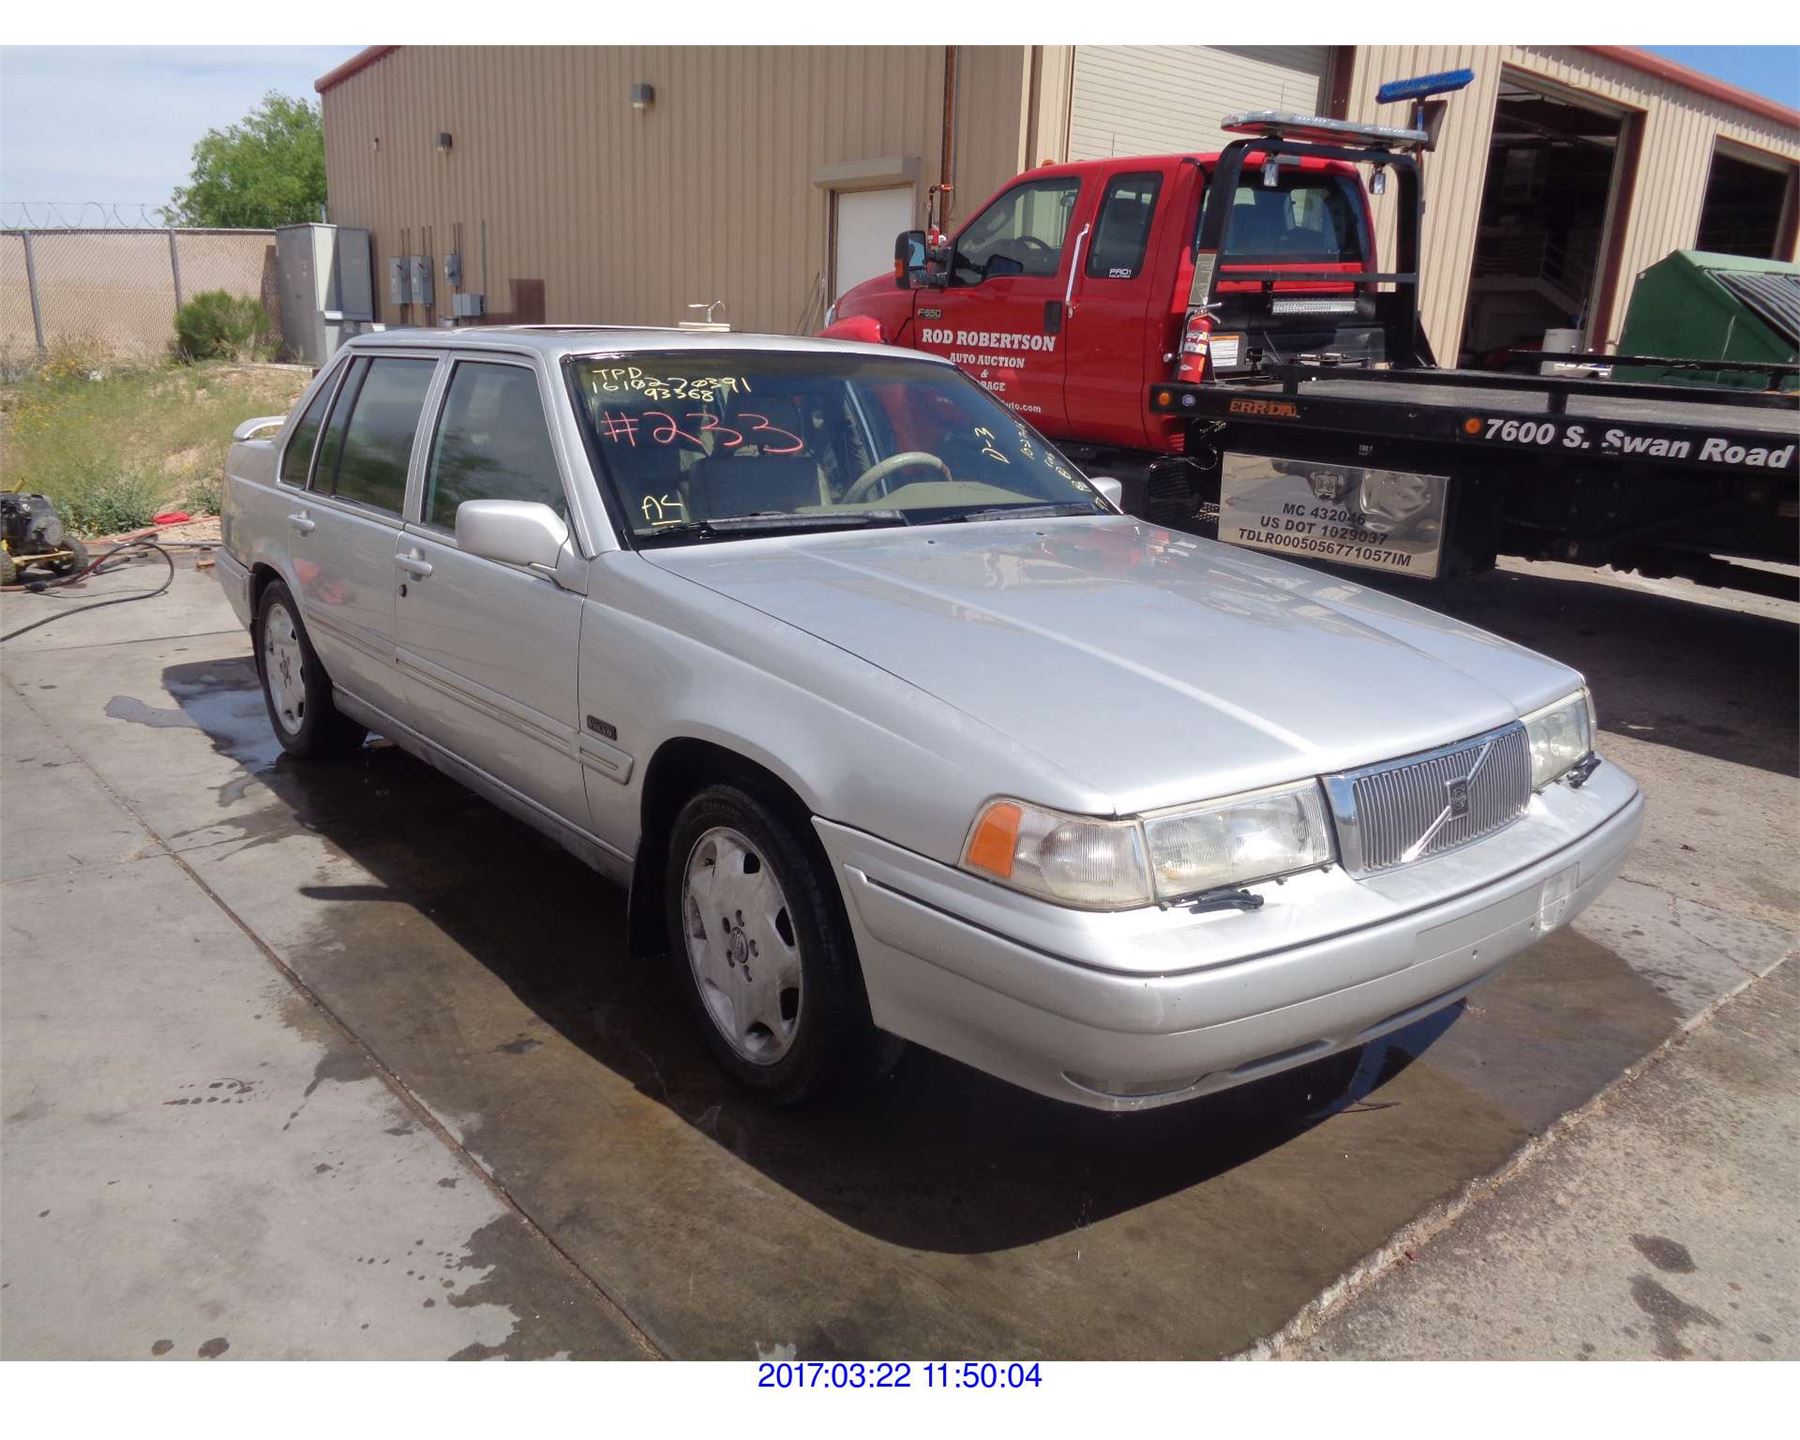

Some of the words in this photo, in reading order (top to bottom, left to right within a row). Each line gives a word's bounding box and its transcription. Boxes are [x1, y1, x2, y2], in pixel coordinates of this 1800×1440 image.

[922, 328, 953, 344] ROD
[956, 330, 1056, 352] ROBERTSON
[950, 352, 975, 365] AUTO
[977, 355, 1025, 369] AUCTION
[592, 367, 642, 381] TPD
[980, 369, 989, 379] &
[980, 380, 1006, 391] RAGE
[601, 410, 804, 454] #233
[1485, 418, 1556, 446] 7600
[1562, 426, 1591, 450] S.
[1601, 429, 1691, 459] Swan
[1698, 437, 1796, 469] Road
[1282, 502, 1306, 517] MC
[1310, 506, 1366, 527] 432046
[1260, 515, 1280, 529] US
[1284, 519, 1317, 534] DOT
[1321, 524, 1390, 546] 1029037
[1238, 528, 1413, 567] TDLR0005056771057IM
